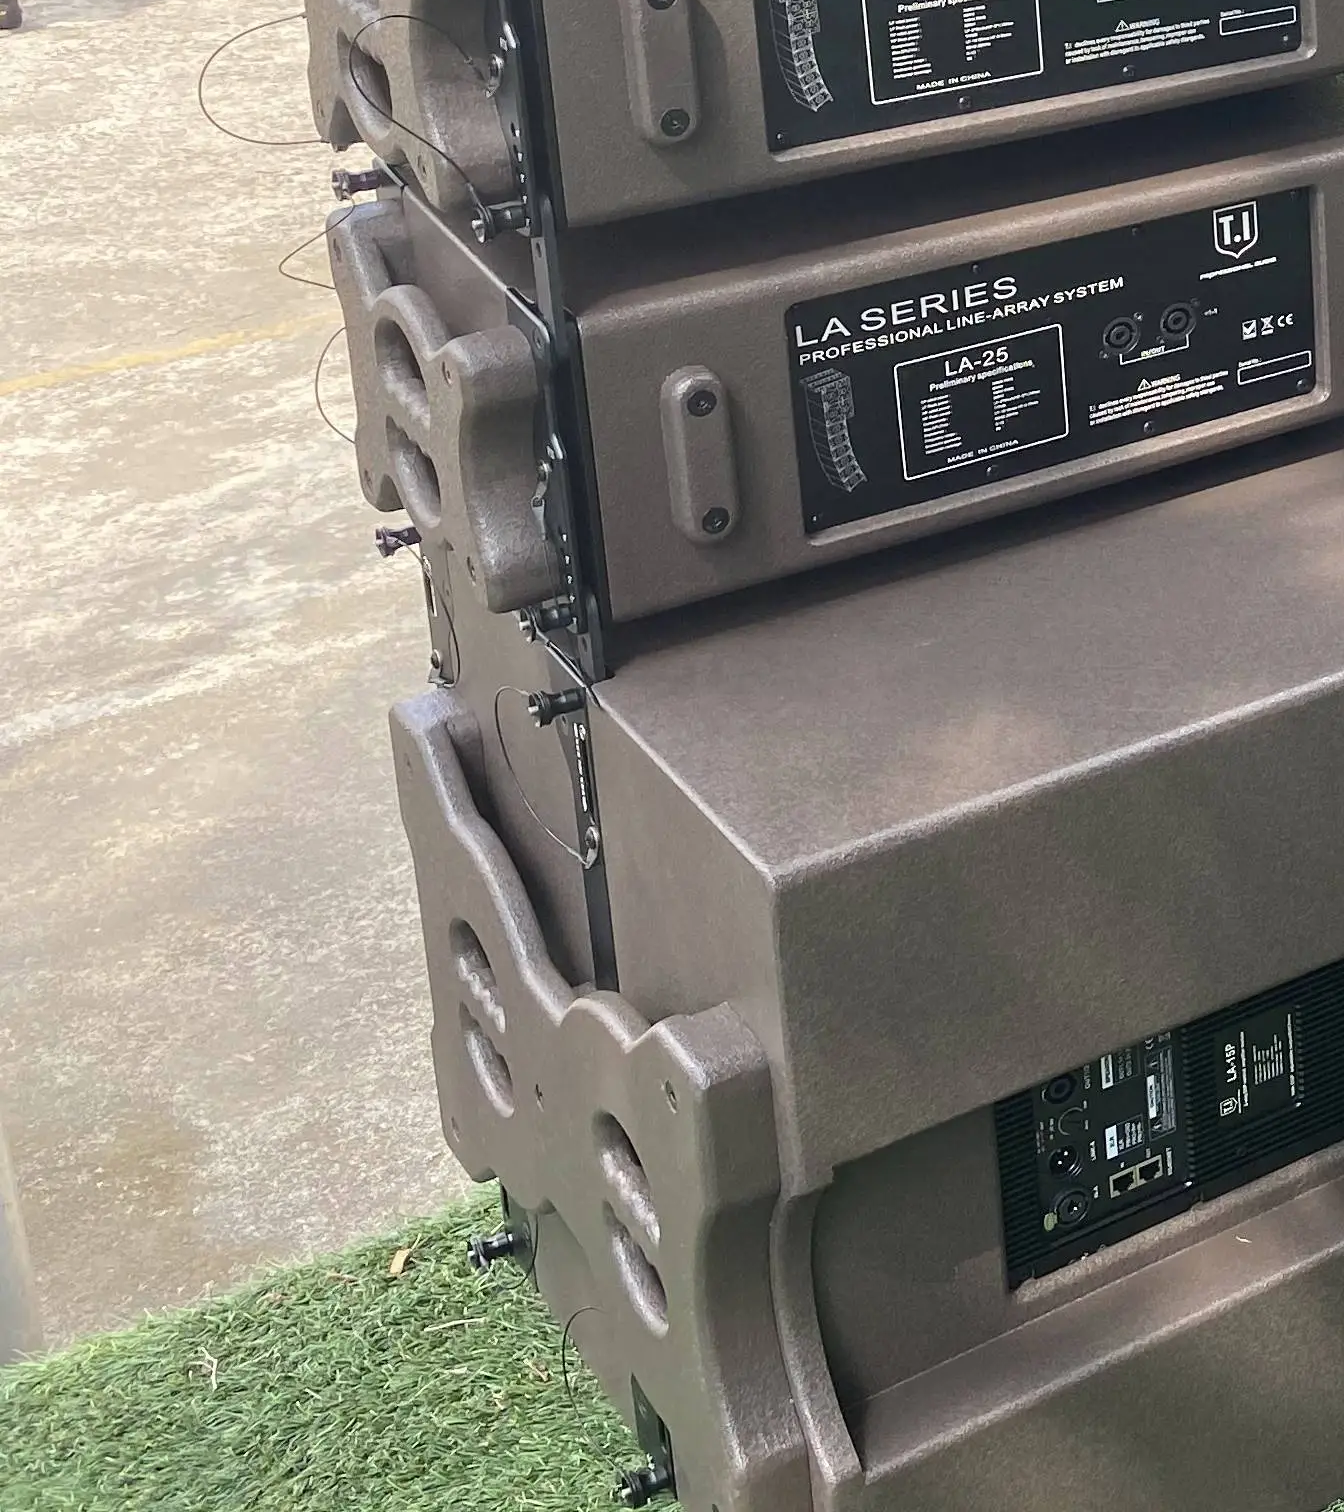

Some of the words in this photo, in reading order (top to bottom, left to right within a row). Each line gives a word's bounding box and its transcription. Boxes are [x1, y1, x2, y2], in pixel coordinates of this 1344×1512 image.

[915, 79, 945, 91] MADE
[947, 76, 960, 85] IN
[959, 70, 992, 83] CHINA
[795, 316, 852, 348] LA
[860, 276, 1018, 332] SERIES
[798, 322, 944, 367] PROFESSIONAL
[945, 294, 1051, 331] LINE-ARRAY
[1053, 276, 1124, 305] SYSTEM
[928, 374, 977, 393] Preliminary
[976, 359, 1034, 381] specifications
[944, 345, 1009, 377] LA-25
[946, 450, 975, 464] MADE
[977, 446, 989, 455] IN
[987, 438, 1020, 452] CHINA
[1224, 1043, 1238, 1084] LA-15P
